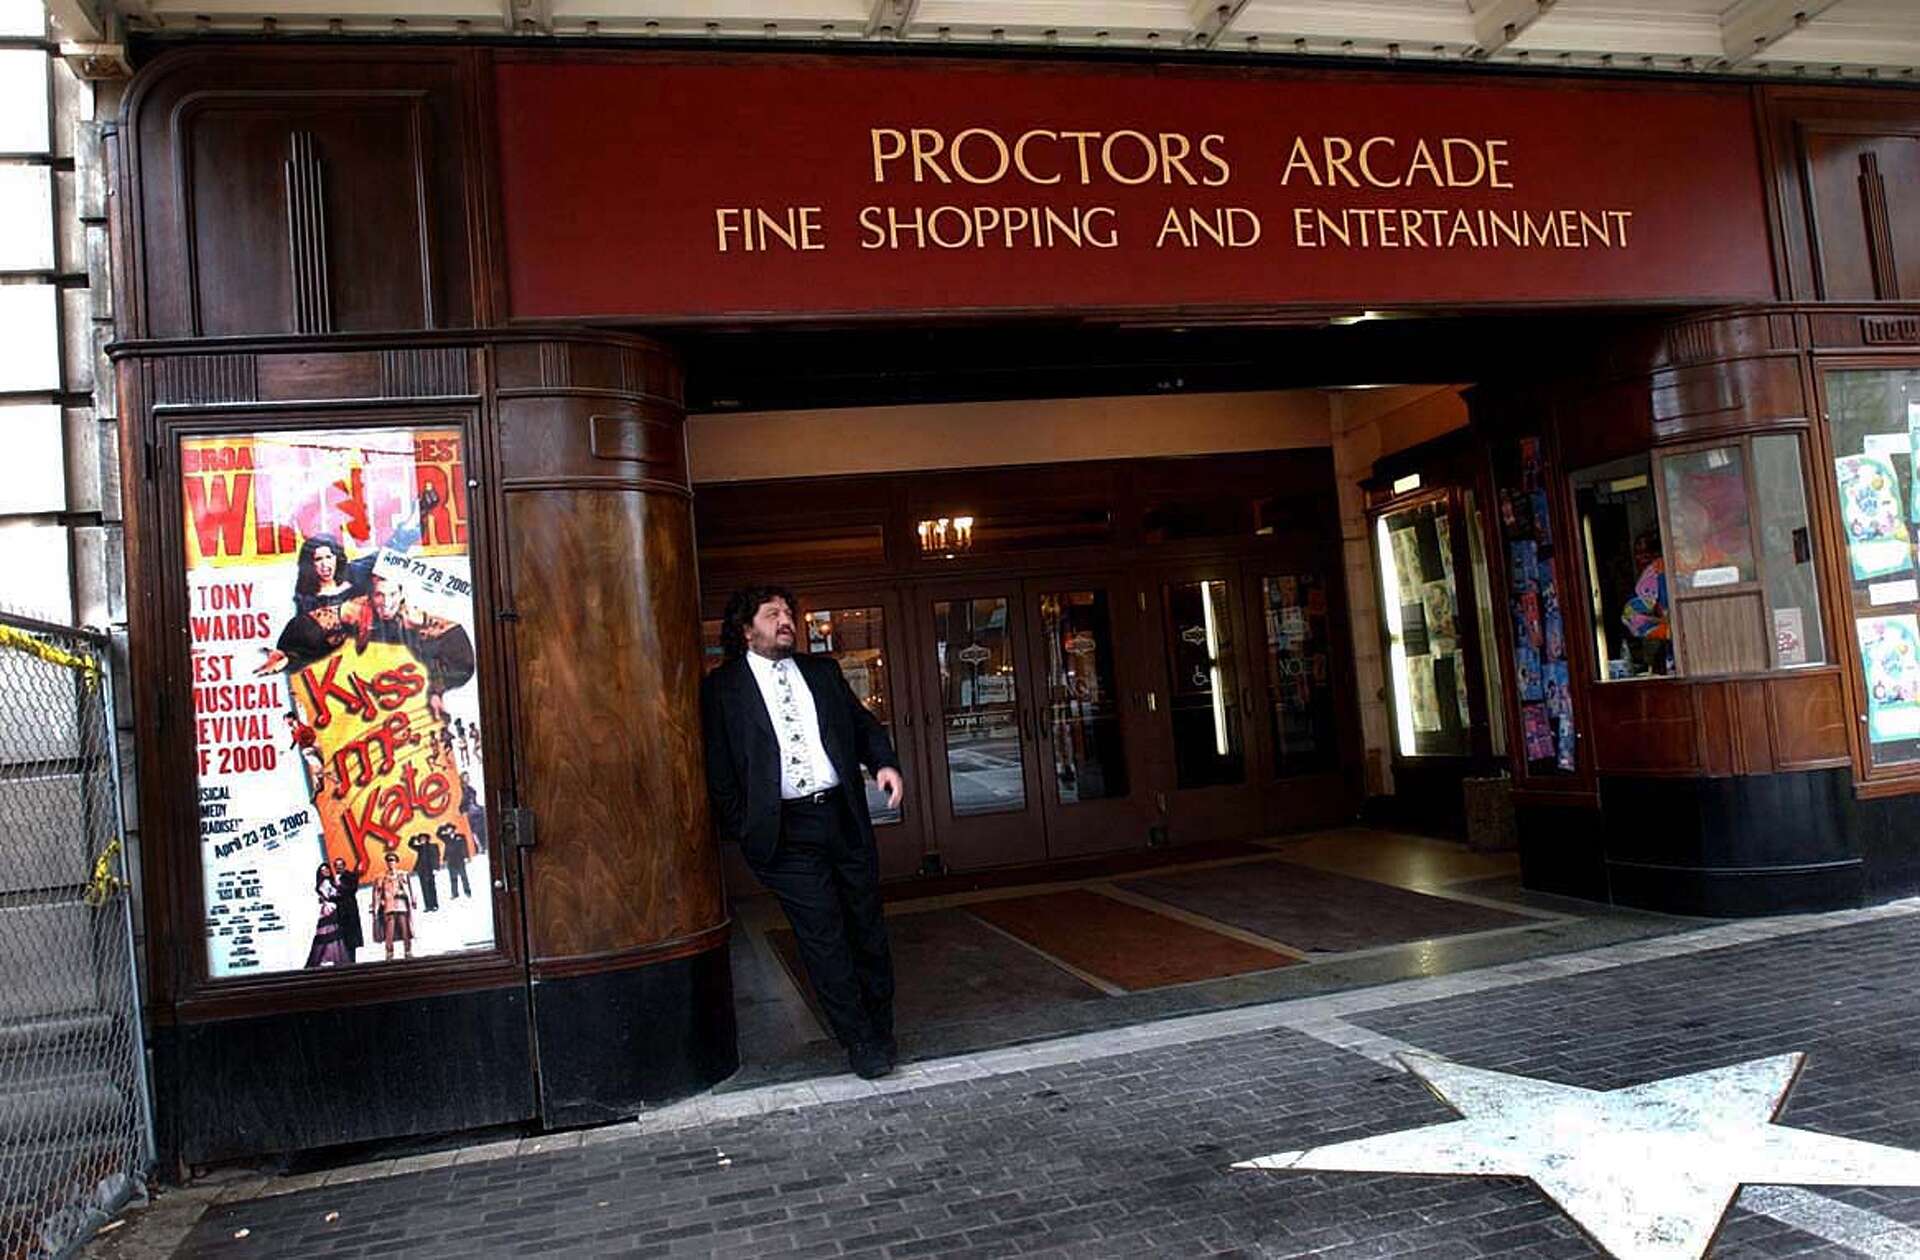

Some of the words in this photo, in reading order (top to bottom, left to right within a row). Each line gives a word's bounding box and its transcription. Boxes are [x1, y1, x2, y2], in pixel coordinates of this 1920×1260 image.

[871, 127, 1231, 186] PROCTORS
[1280, 135, 1515, 189] ARCADE
[715, 206, 826, 252] FINE
[859, 205, 1120, 250] SHOPPING
[1156, 206, 1262, 249] AND
[1294, 207, 1633, 249] ENTERTAINMENT
[198, 583, 254, 611] TONY
[197, 714, 274, 745] EVIVAL
[217, 744, 277, 775] 2000
[343, 760, 450, 875] Kate
[214, 837, 243, 859] April
